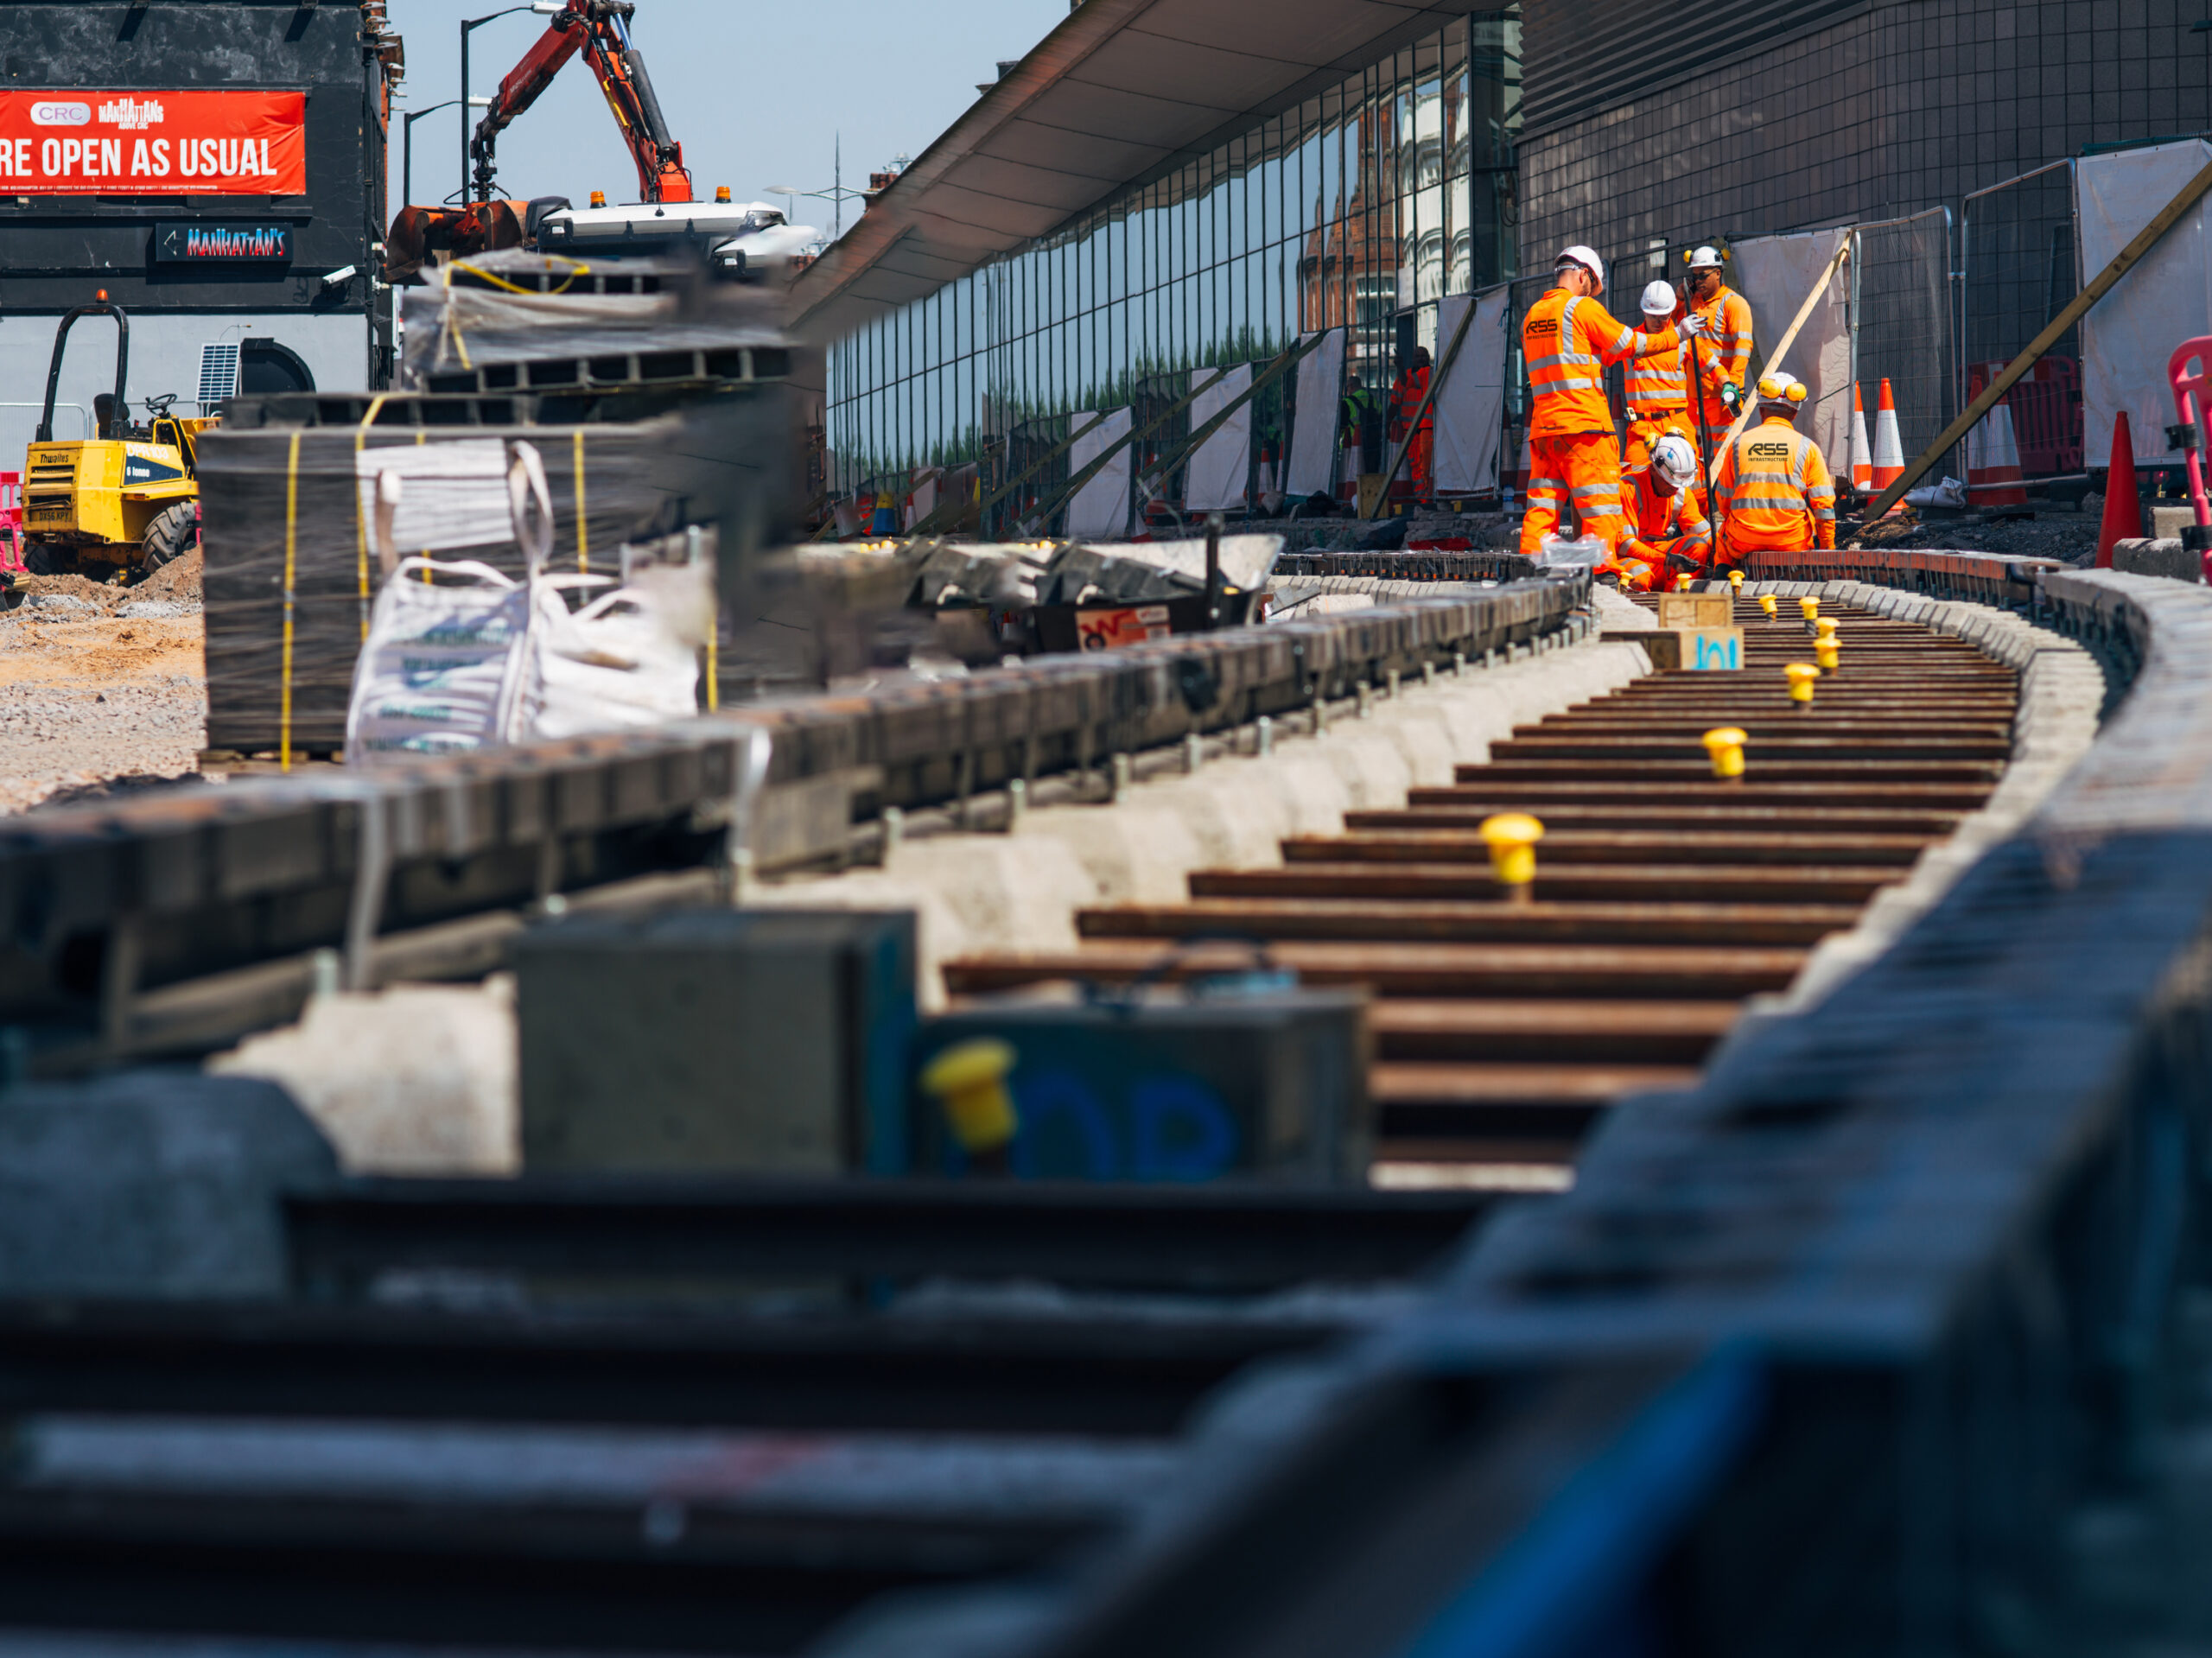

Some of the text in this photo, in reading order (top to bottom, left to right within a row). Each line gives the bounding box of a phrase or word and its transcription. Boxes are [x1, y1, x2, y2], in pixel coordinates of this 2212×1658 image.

[39, 106, 83, 121] CRC
[41, 138, 121, 176] OPEN
[130, 138, 170, 176] AS
[180, 138, 277, 176] USUAL
[187, 227, 286, 257] MANHATTAN'S
[1526, 318, 1558, 334] RSS
[1747, 442, 1789, 456] RSS
[40, 454, 69, 464] Thwaites
[132, 467, 149, 477] tonne
